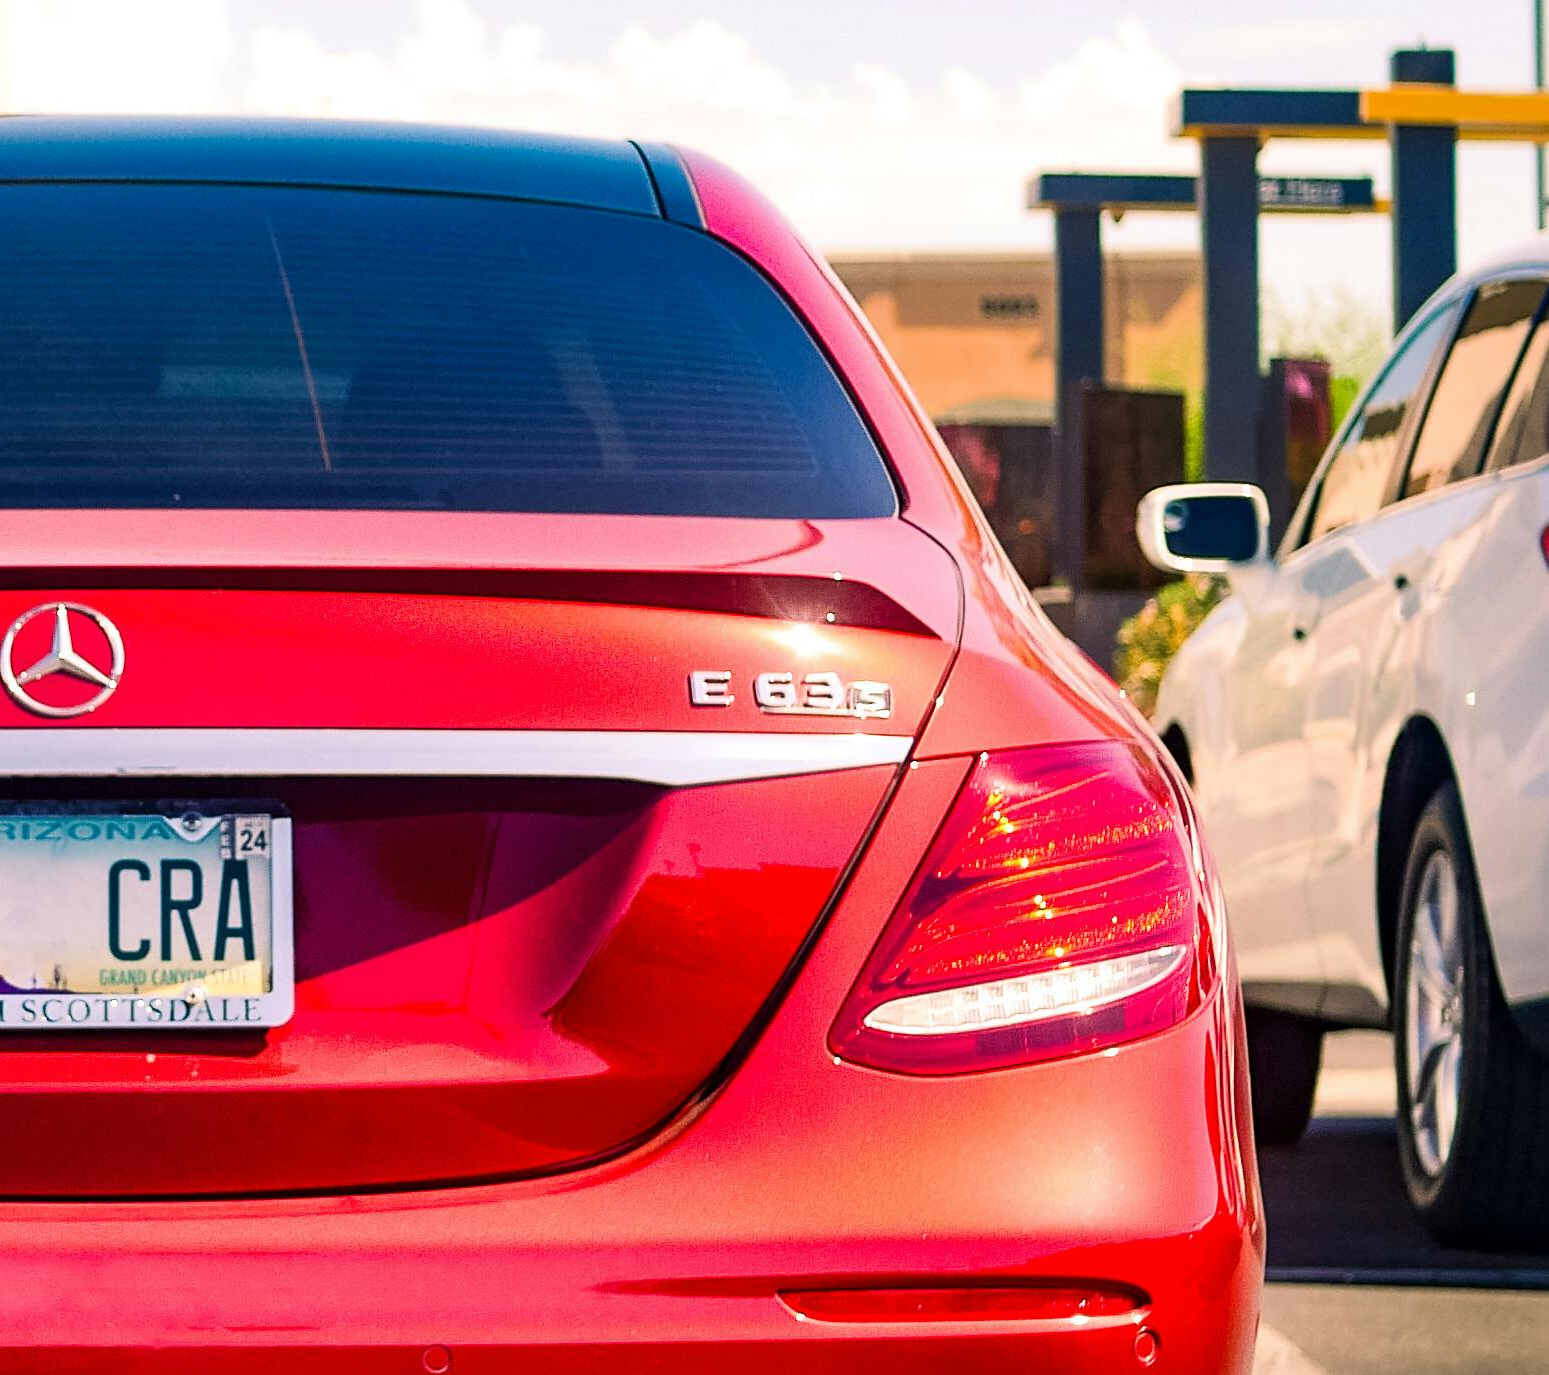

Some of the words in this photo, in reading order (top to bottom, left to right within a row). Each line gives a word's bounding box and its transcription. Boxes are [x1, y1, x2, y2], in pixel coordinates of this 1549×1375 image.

[690, 671, 735, 707] E
[240, 828, 267, 851] 24
[108, 858, 256, 961] CRA
[99, 969, 147, 985] GRAND
[21, 998, 262, 1023] SCOTTSDALE
